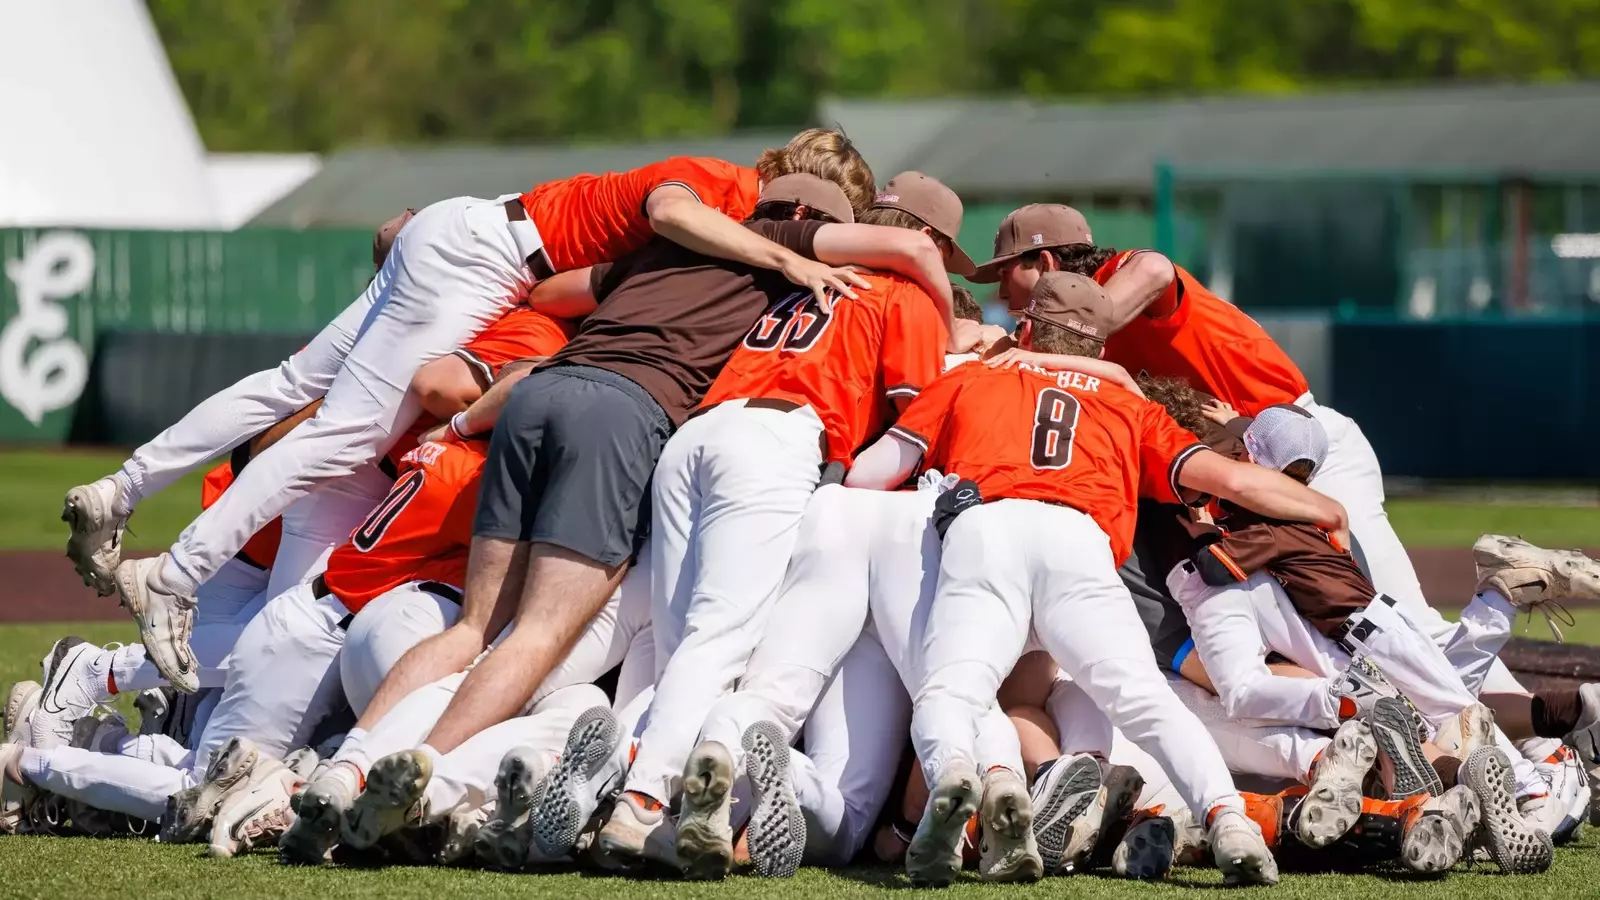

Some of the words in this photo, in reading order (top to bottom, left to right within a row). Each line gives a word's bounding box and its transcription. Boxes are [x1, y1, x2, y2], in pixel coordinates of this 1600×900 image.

[1018, 362, 1100, 392] HER
[1030, 387, 1081, 470] 8
[350, 468, 425, 553] 0
